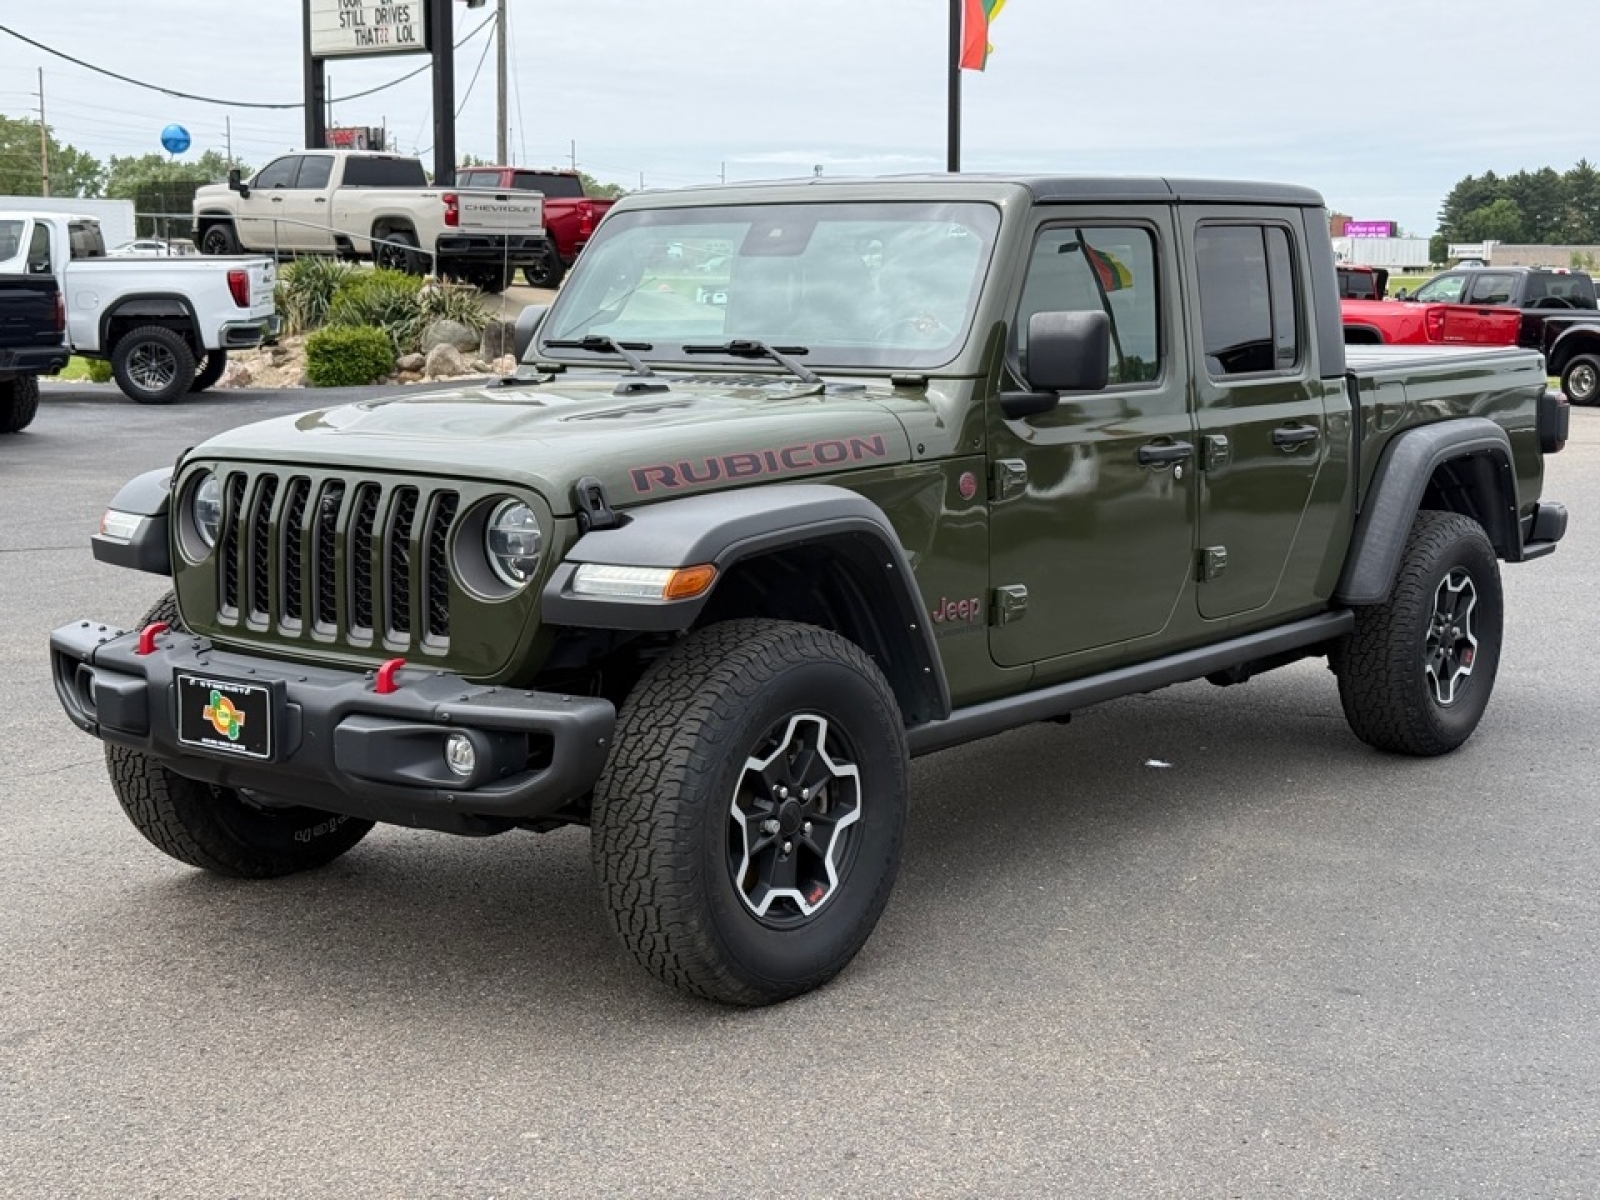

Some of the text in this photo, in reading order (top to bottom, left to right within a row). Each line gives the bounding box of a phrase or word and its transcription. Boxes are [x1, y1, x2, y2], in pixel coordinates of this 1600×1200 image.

[339, 5, 411, 28] STILL DRIVES
[396, 25, 416, 42] LOL
[464, 204, 537, 213] CHEVROLET
[629, 435, 886, 493] RUBICON
[931, 597, 980, 624] Jeep
